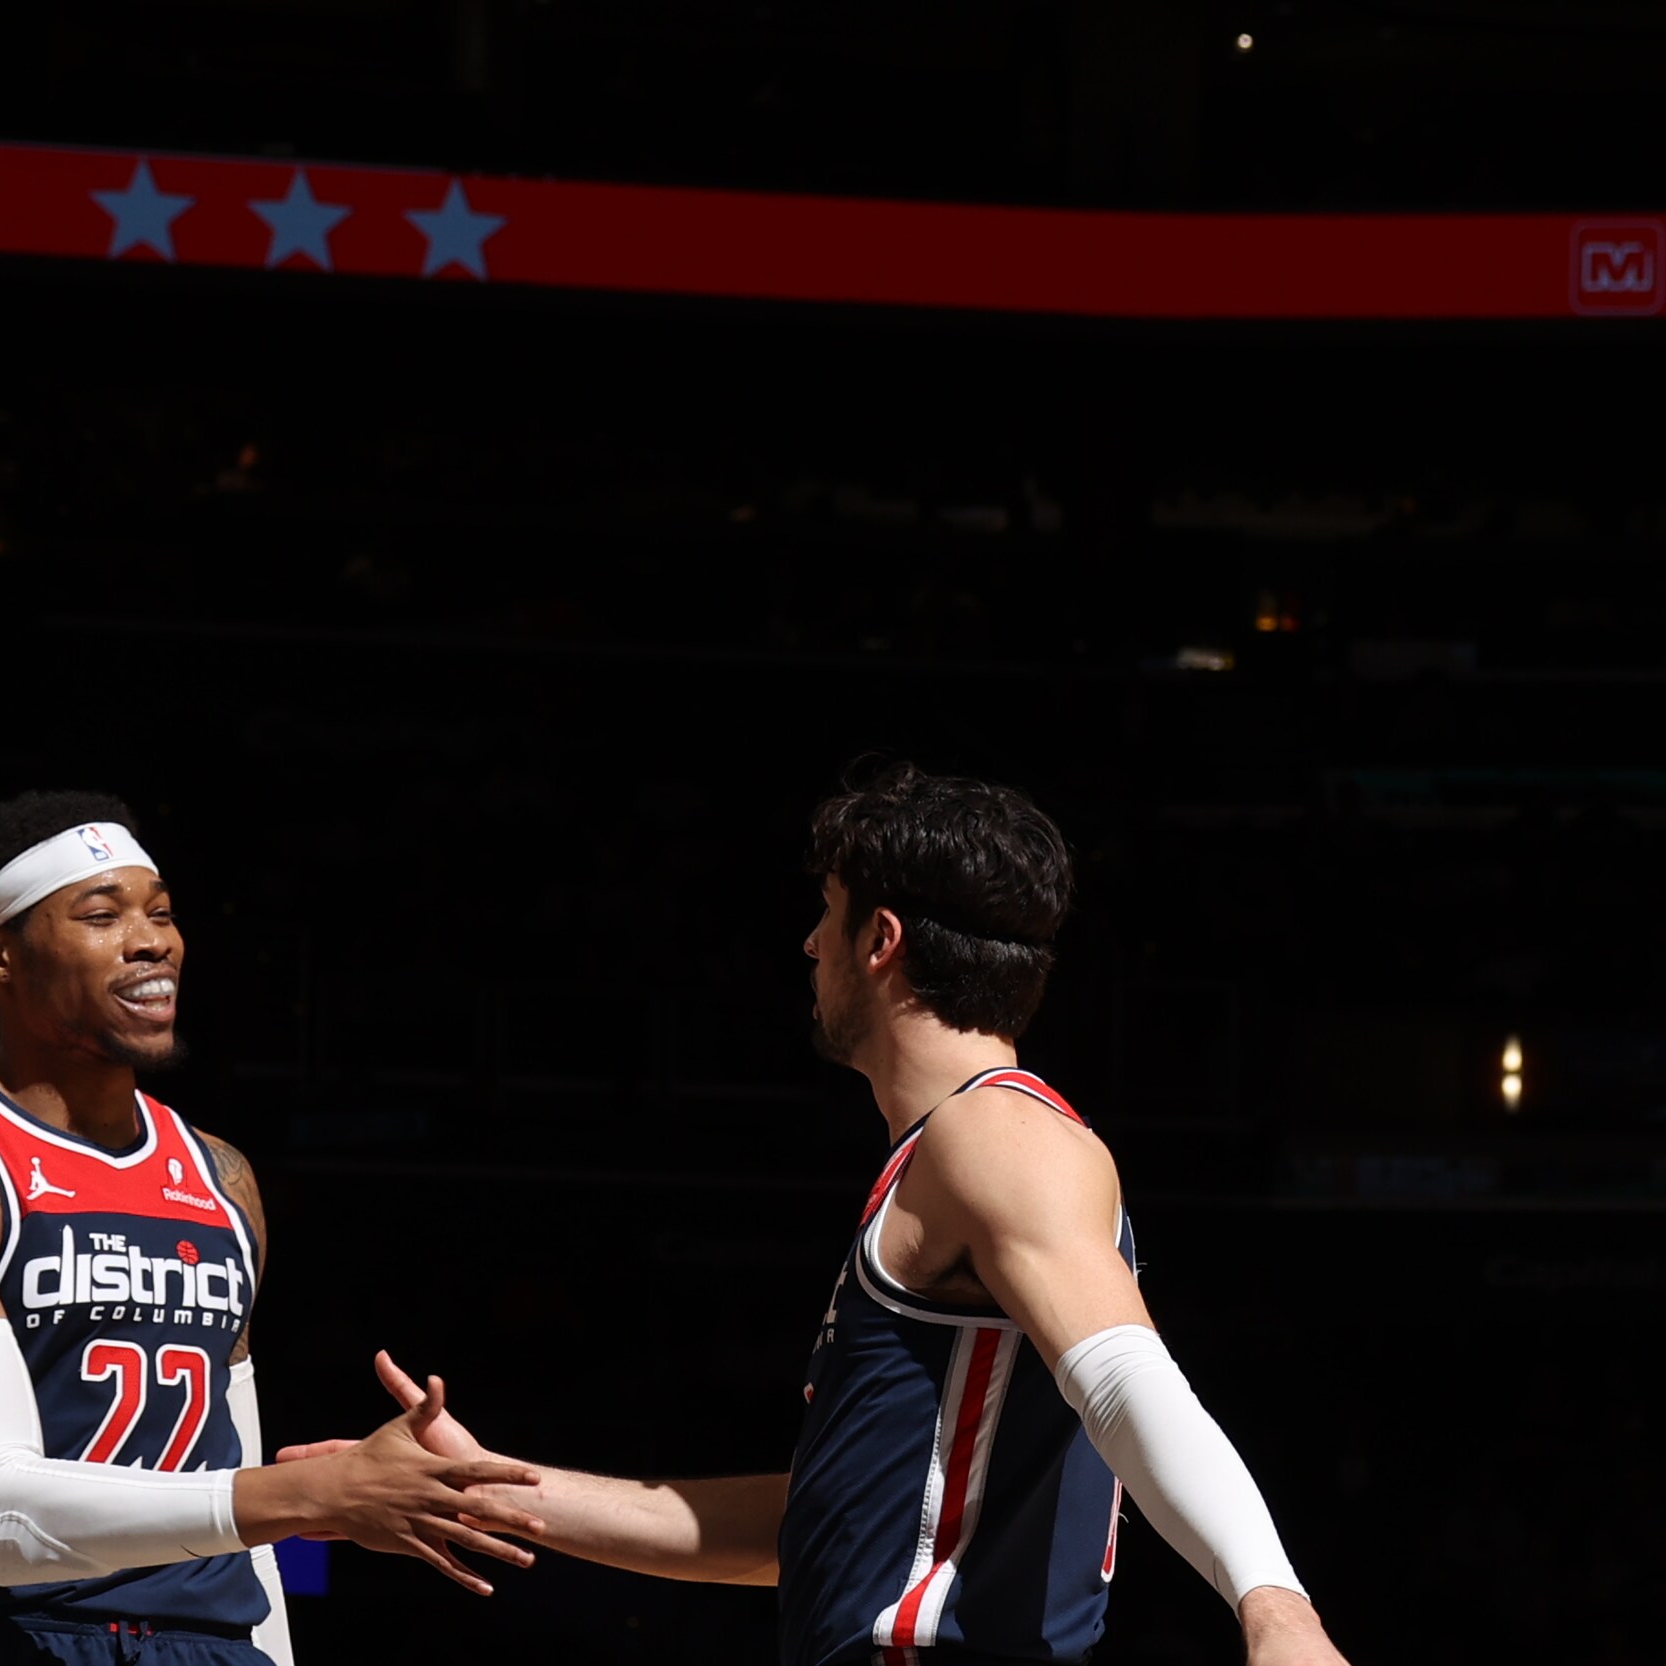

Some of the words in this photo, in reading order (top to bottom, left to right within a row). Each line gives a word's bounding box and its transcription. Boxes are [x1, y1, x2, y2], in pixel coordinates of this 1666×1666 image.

[21, 1223, 244, 1317] district
[88, 1232, 127, 1252] THE
[25, 1309, 65, 1329] OF
[89, 1305, 242, 1334] COLUMBIA
[80, 1338, 212, 1473] 22
